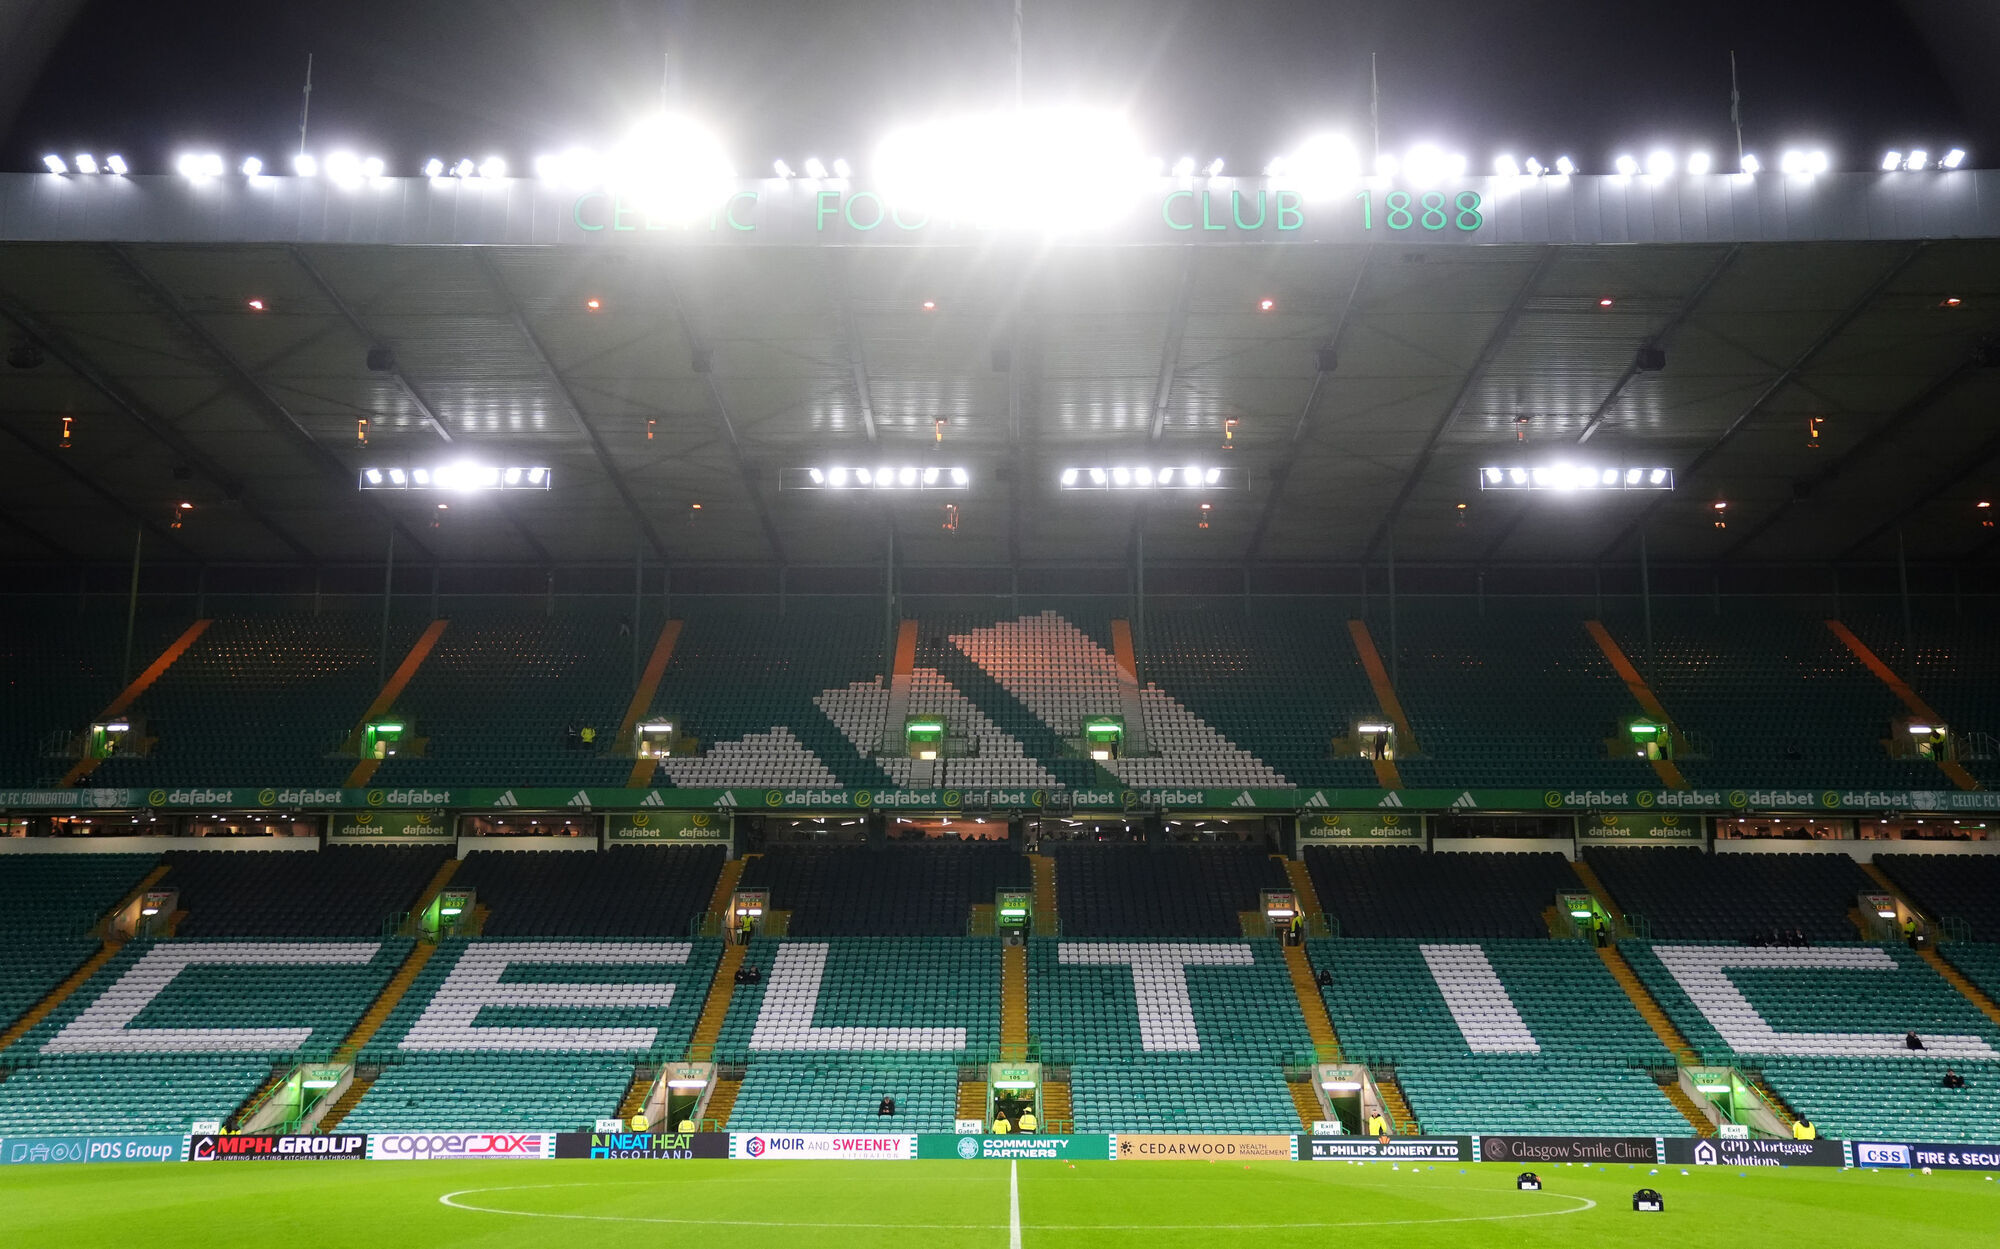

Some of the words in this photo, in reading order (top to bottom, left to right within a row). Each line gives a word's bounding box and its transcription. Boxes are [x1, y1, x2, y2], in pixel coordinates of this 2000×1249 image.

[1161, 190, 1304, 231] CLUB
[1356, 190, 1483, 231] 1888
[21, 792, 78, 804] FOUNDATION
[168, 789, 233, 805] dafabet
[277, 789, 342, 805] dafabet
[386, 789, 450, 805] dafabet
[785, 790, 848, 806] dafabet
[873, 790, 936, 806] dafabet
[964, 790, 1026, 806] dafabet
[1139, 790, 1204, 806] dafabet
[1564, 790, 1628, 806] dafabet
[1656, 790, 1721, 806] dafabet
[1749, 791, 1814, 807] dafabet
[1842, 792, 1908, 808] dafabet
[342, 824, 383, 836] dafabet
[402, 824, 444, 836] dafabet
[618, 827, 660, 839] dafabet
[679, 827, 721, 839] dafabet
[1310, 826, 1351, 838] dafabet
[1370, 826, 1412, 838] dafabet
[1588, 826, 1630, 838] dafabet
[1649, 826, 1692, 838] dafabet
[39, 941, 2000, 1060] CELTIC
[217, 1137, 362, 1153] MPH.GROUP
[610, 1134, 652, 1149] NEAT
[652, 1134, 694, 1149] HEAT
[770, 1138, 804, 1150] MOIR
[808, 1141, 829, 1151] AND
[833, 1138, 901, 1151] SWEENEY
[983, 1139, 1069, 1149] COMMUNITY
[1139, 1143, 1236, 1154] CEDARWOOD
[1720, 1140, 1750, 1152] GPD
[1753, 1140, 1813, 1155] Mortgage
[90, 1142, 121, 1159] POS
[125, 1142, 173, 1162] Group
[610, 1150, 693, 1159] SCOTLAND
[983, 1149, 1057, 1158] PARTNERS
[1312, 1145, 1327, 1155] M.
[1329, 1145, 1377, 1156] PHILIPS
[1379, 1146, 1434, 1156] JOINERY
[1436, 1146, 1459, 1156] LTD
[1511, 1142, 1570, 1161] Glasgow
[1572, 1142, 1611, 1158] Smile
[1613, 1143, 1653, 1158] Clinic
[1722, 1154, 1780, 1166] Solutions
[1916, 1152, 1946, 1164] FIRE
[1948, 1153, 1960, 1165] &
